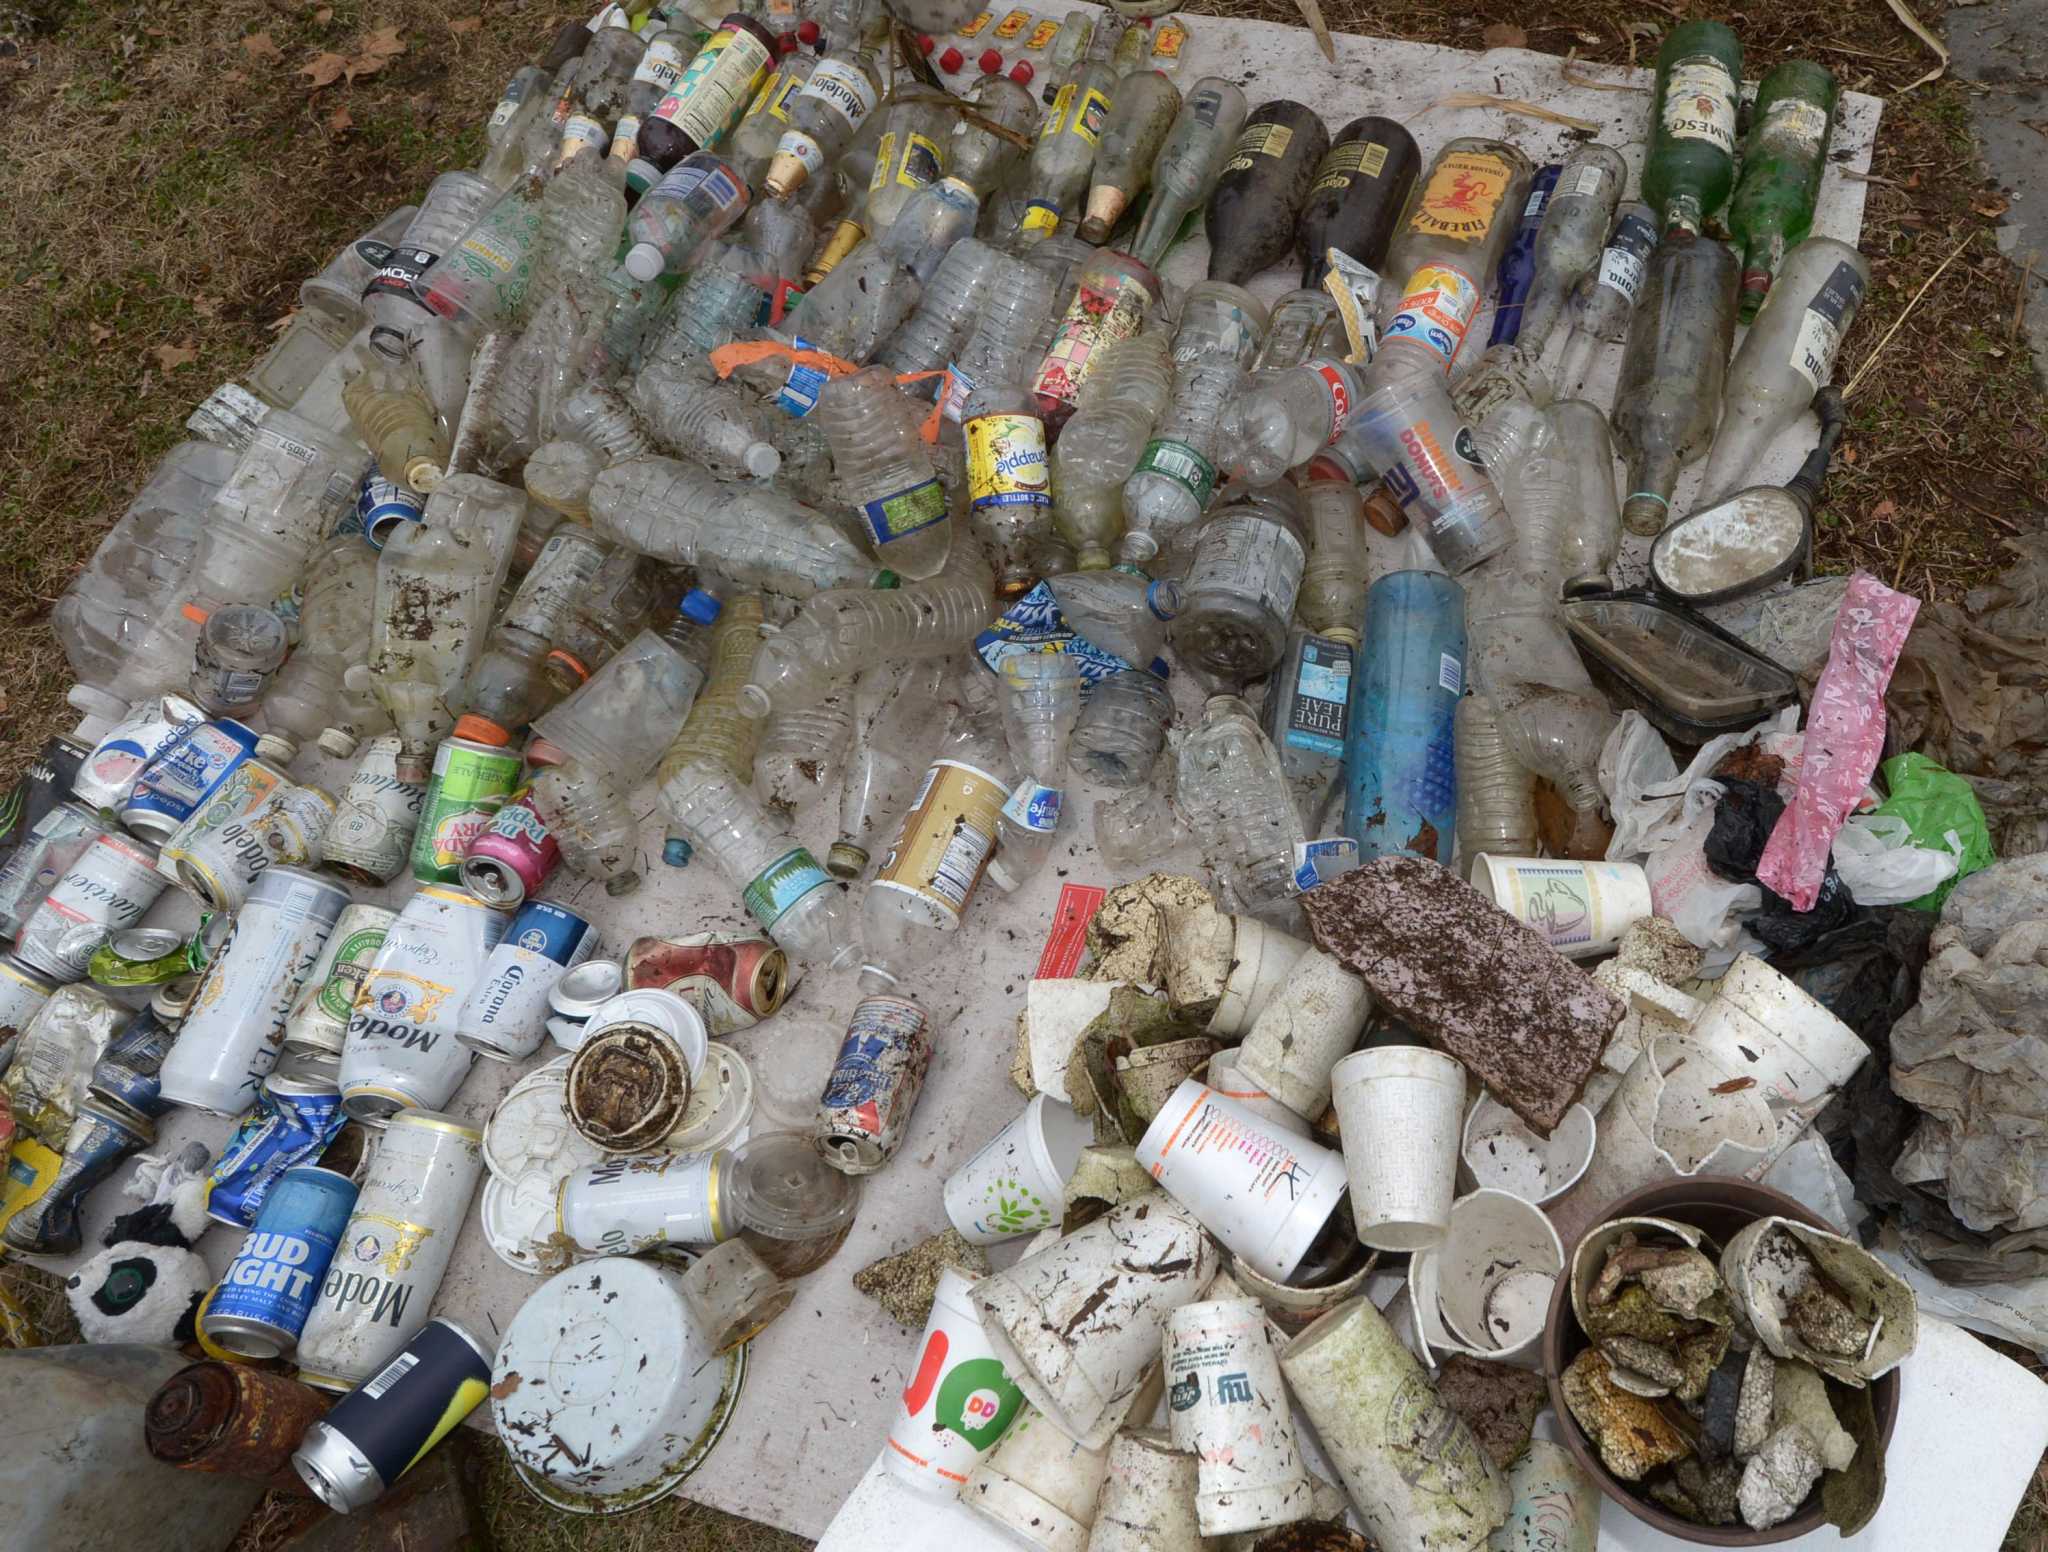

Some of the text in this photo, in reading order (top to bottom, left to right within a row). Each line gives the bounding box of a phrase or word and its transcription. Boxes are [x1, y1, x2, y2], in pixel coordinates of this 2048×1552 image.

[815, 78, 862, 117] Modelo
[1417, 210, 1485, 232] FIREBALL
[281, 440, 315, 461] FROST
[1001, 603, 1057, 625] risk
[1296, 710, 1341, 732] PURE
[1302, 697, 1343, 718] LEAF
[500, 807, 546, 843] Pepp
[482, 965, 524, 1025] Corona
[350, 1016, 441, 1053] Mode
[221, 1258, 314, 1299] IGHT
[324, 1269, 414, 1328] Mode
